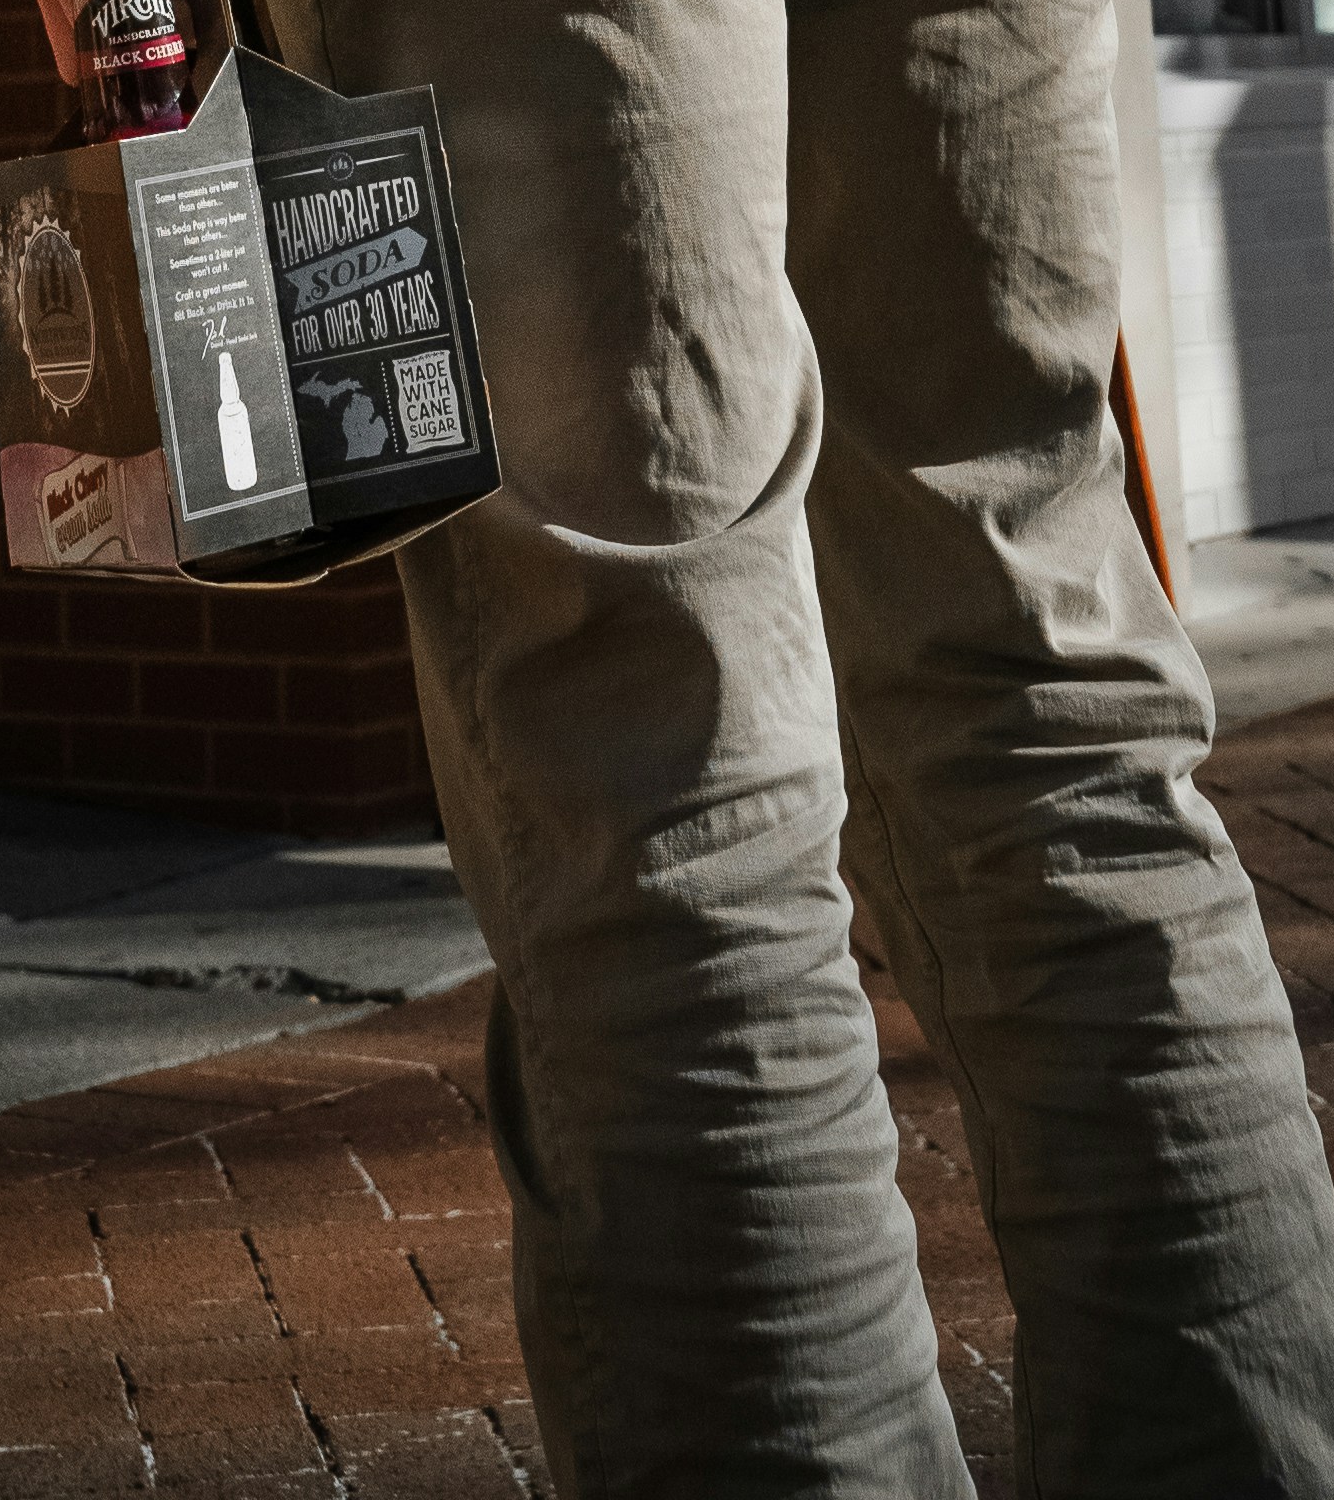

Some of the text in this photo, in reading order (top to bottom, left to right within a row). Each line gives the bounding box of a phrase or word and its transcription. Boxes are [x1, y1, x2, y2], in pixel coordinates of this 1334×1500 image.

[108, 23, 176, 46] HANDCRAFTED
[93, 50, 144, 71] BLACK
[155, 181, 239, 204] Some moments are better
[179, 201, 196, 212] than
[156, 212, 247, 238] This Soda Pop is way better
[272, 176, 420, 269] HANDCRAFTED
[183, 234, 200, 246] than
[169, 255, 207, 270] Sometimes
[211, 263, 222, 274] cut
[311, 239, 407, 300] SODA
[175, 288, 194, 302] Craft
[202, 284, 221, 300] great
[292, 269, 440, 356] FOR OVER 30 YEARS
[400, 360, 447, 384] MADE
[403, 378, 450, 402] WITH
[407, 397, 453, 422] CANE
[409, 417, 457, 438] SUGAR
